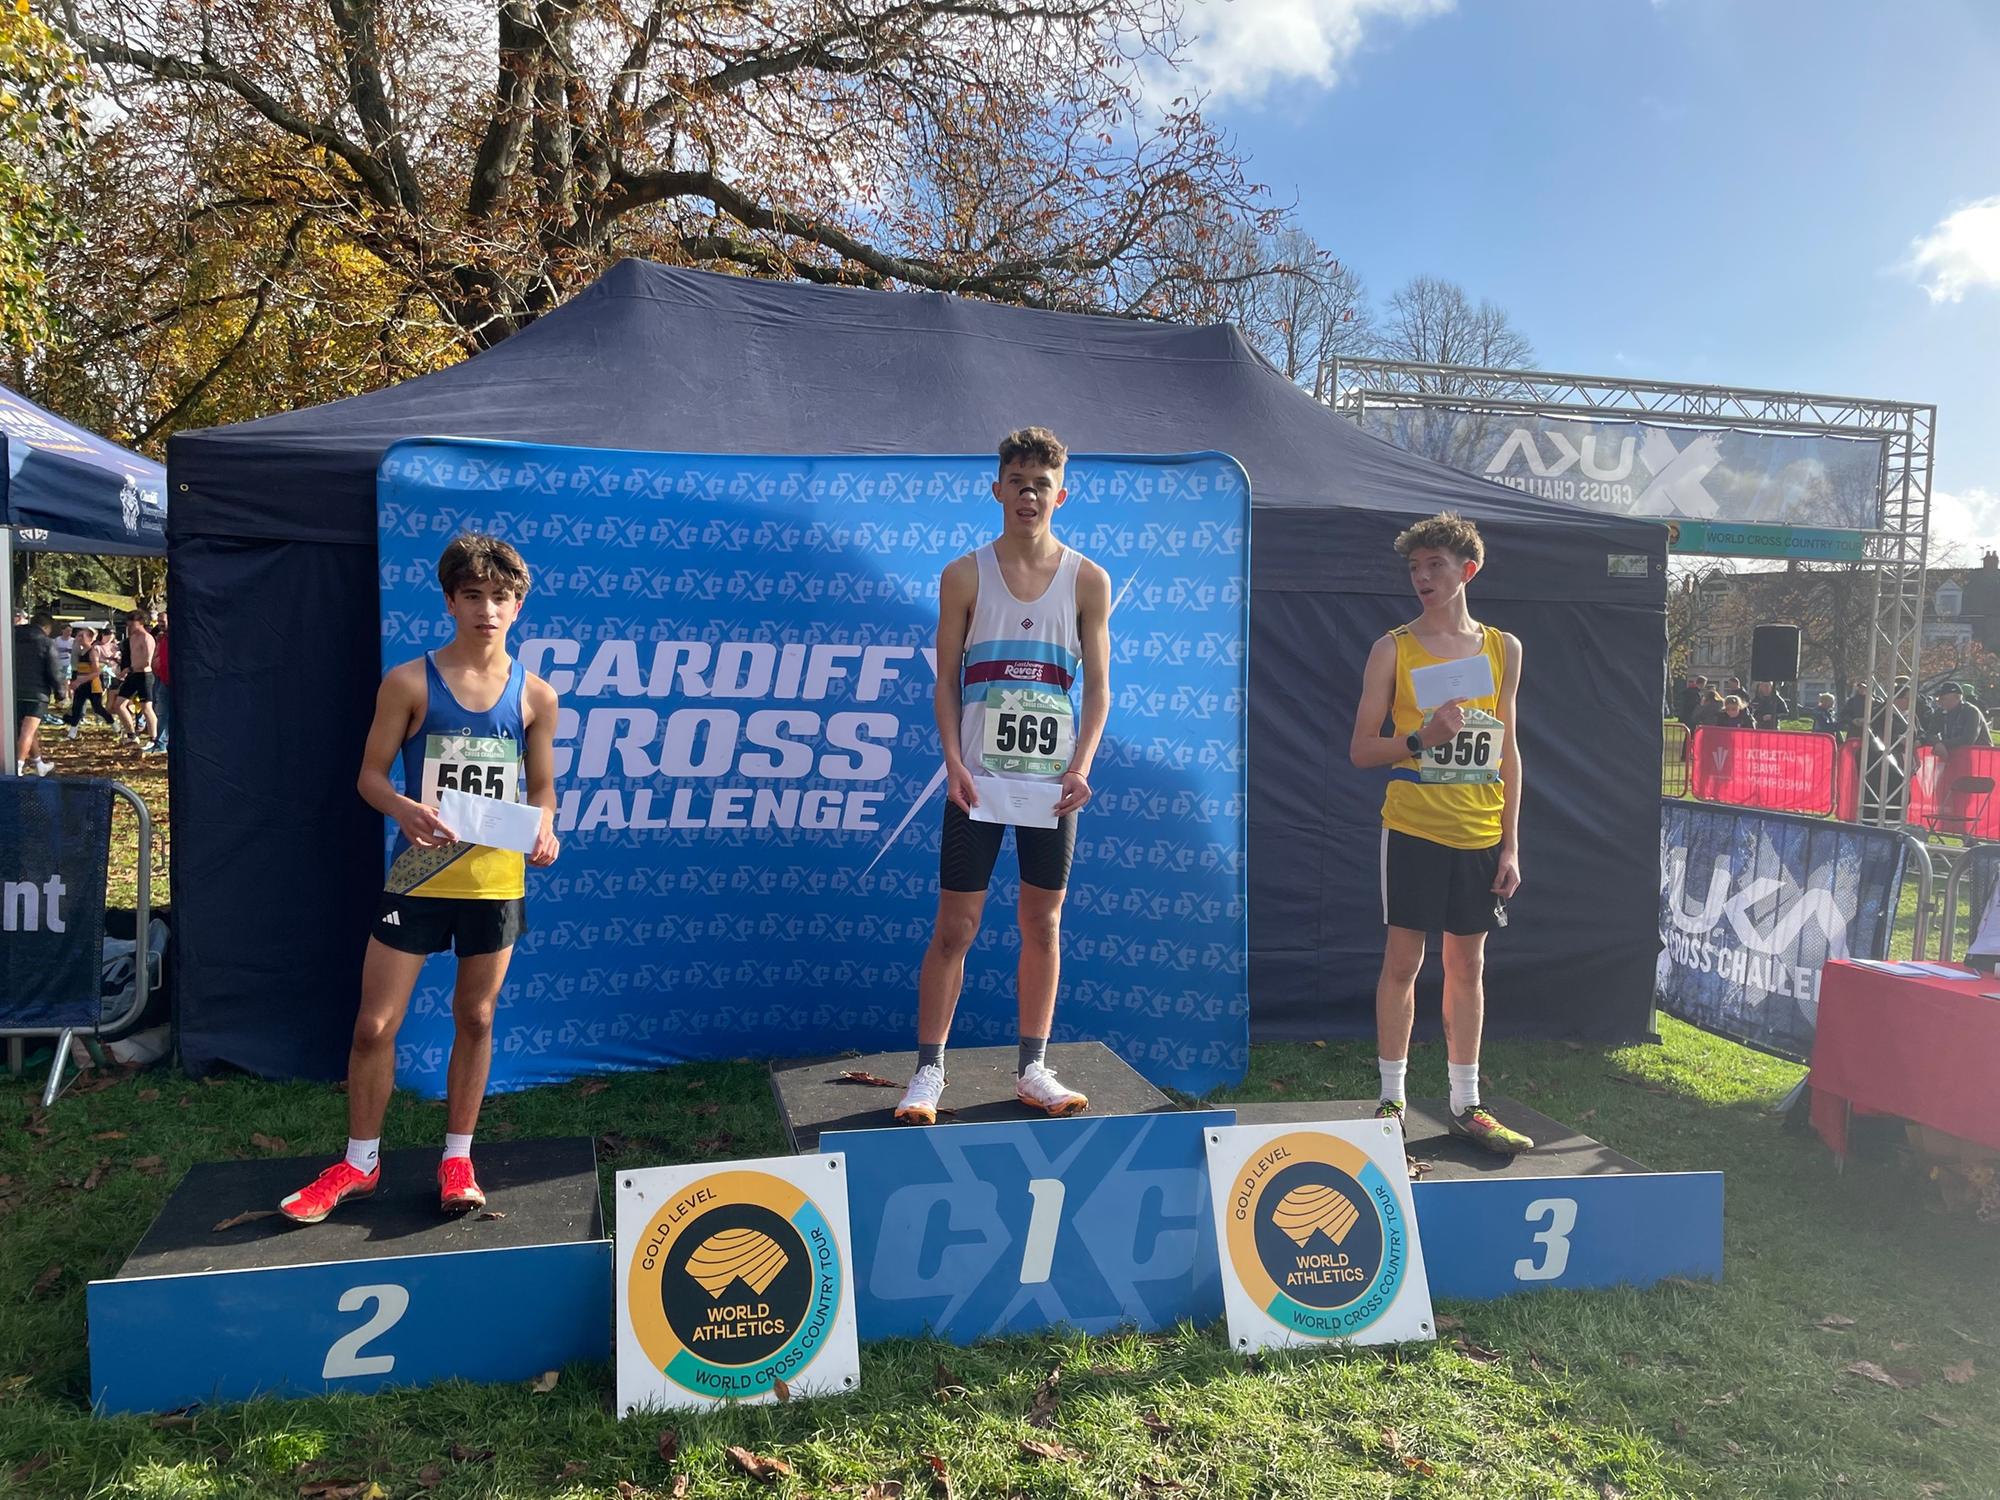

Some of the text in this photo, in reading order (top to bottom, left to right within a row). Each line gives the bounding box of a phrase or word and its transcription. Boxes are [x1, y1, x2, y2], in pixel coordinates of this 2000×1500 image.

[1707, 531, 1745, 545] WORLD
[1747, 534, 1782, 547] CROSS
[1784, 536, 1832, 550] COUNTRY
[521, 638, 914, 701] CARDIFF
[1004, 664, 1043, 678] Rovers
[996, 713, 1059, 755] 569
[1434, 731, 1491, 767] 556
[436, 763, 505, 802] 565
[554, 789, 885, 831] HALLENGE
[1668, 930, 1822, 1003] CROSS CHALLE
[1236, 1146, 1291, 1221] GOLD LEVEL
[642, 1187, 717, 1271] GOLD LEVEL
[1019, 1178, 1066, 1284] 1
[1513, 1198, 1578, 1281] 3
[1286, 1268, 1364, 1286] ATHLETICS
[1293, 1184, 1400, 1330] WORLD CROSS COUNTRY TOUR
[1296, 1253, 1349, 1269] WORLD
[695, 1227, 834, 1390] WORLD CROSS COUNTRY TOUR
[707, 1303, 770, 1323] WORLD
[321, 1284, 410, 1379] 2
[692, 1319, 785, 1342] ATHLETICS
